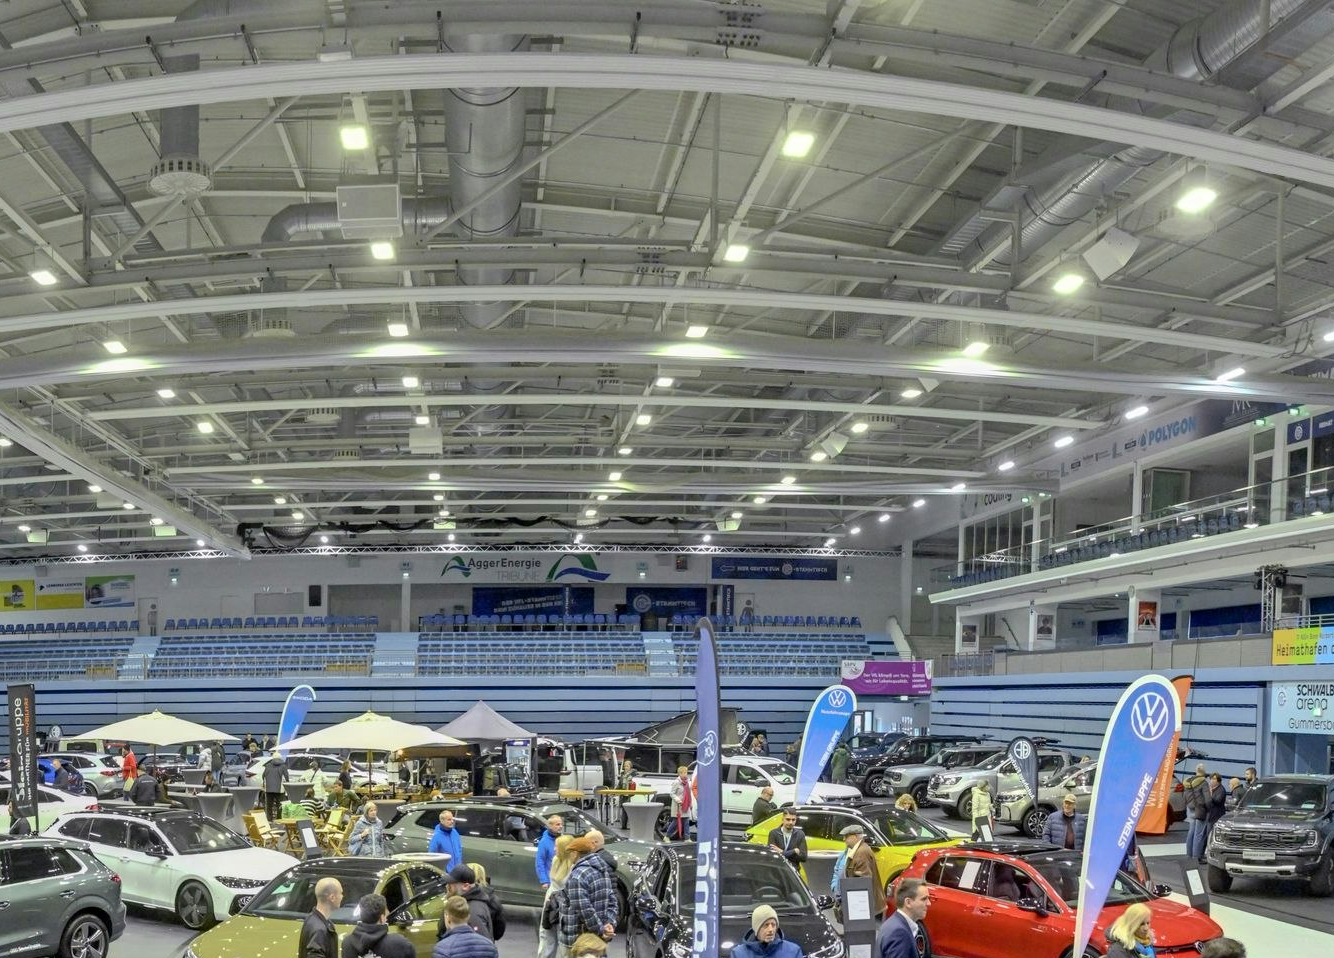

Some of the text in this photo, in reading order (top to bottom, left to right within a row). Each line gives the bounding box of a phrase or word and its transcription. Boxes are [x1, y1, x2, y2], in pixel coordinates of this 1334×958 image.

[1148, 416, 1197, 445] POLYGON
[467, 558, 541, 569] AggerEnergie
[1277, 642, 1327, 656] Heimathafen
[1297, 698, 1328, 710] arena
[1118, 773, 1153, 849] STEIN GRUPPE
